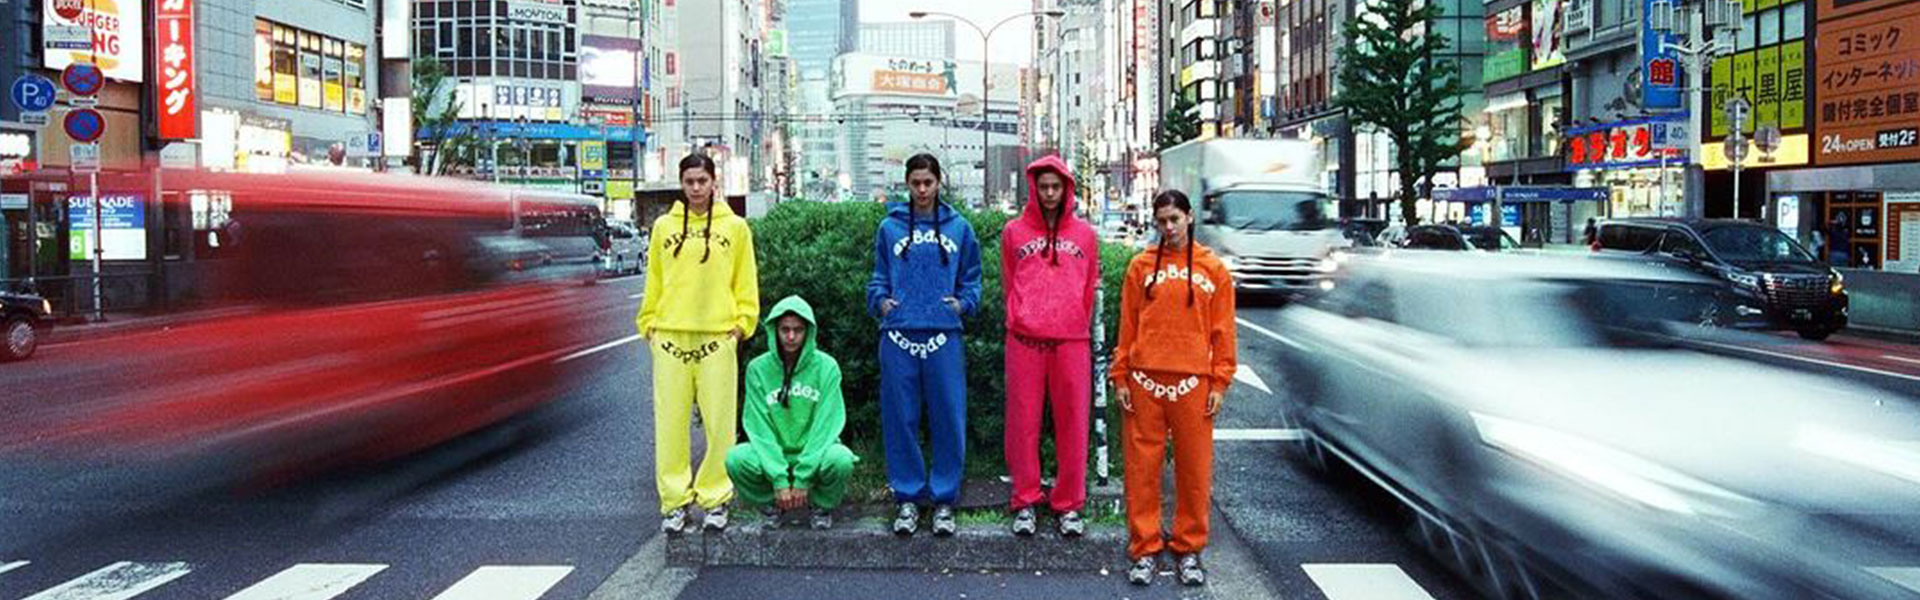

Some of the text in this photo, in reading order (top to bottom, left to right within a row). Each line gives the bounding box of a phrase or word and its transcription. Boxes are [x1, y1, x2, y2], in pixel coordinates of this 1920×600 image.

[70, 10, 120, 31] URGER
[91, 32, 120, 56] NG
[1838, 26, 1900, 56] コミック
[1735, 68, 1804, 107] 大黒屋
[1822, 58, 1919, 90] インターネット
[22, 83, 39, 106] P
